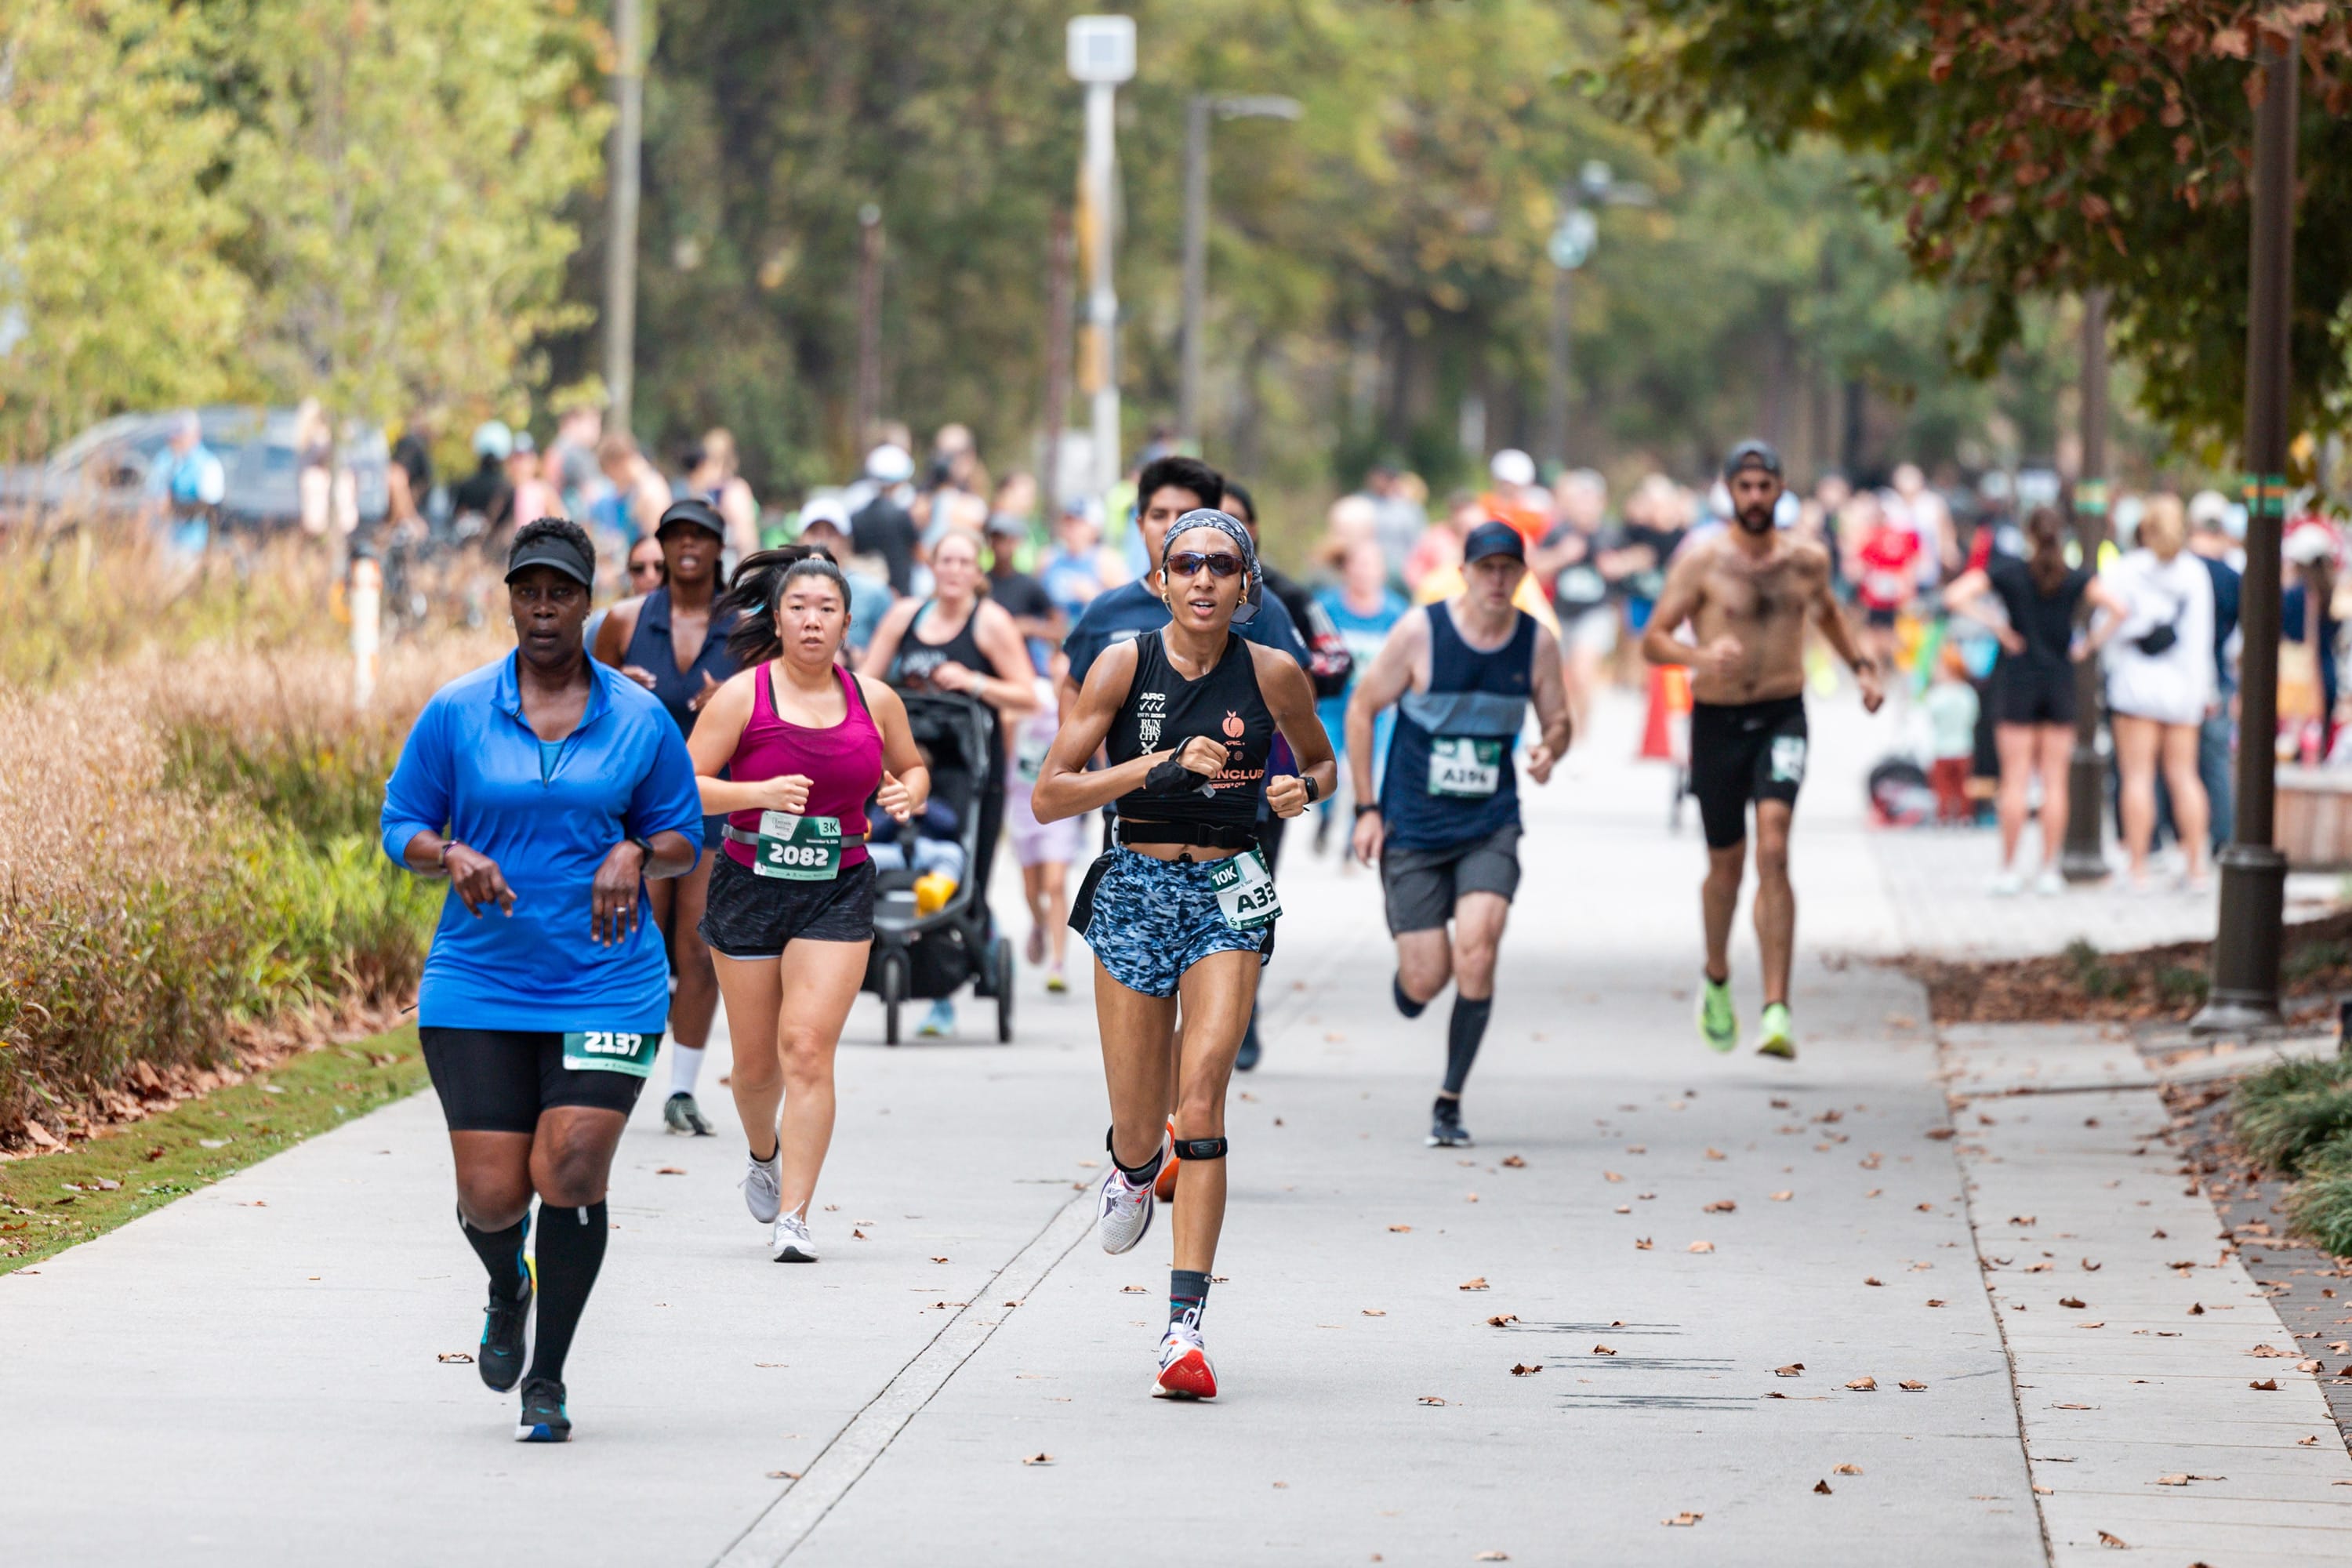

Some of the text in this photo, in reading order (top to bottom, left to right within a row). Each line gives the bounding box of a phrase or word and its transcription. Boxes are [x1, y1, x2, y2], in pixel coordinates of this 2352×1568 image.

[1140, 692, 1166, 701] ARC
[1141, 719, 1161, 728] RUN
[1140, 726, 1161, 735] THIS
[1215, 769, 1265, 780] NCLUB
[822, 822, 838, 833] 3K
[768, 842, 829, 866] 2082
[1211, 865, 1238, 887] 10K
[1237, 881, 1277, 914] A33
[583, 1031, 643, 1057] 2137
